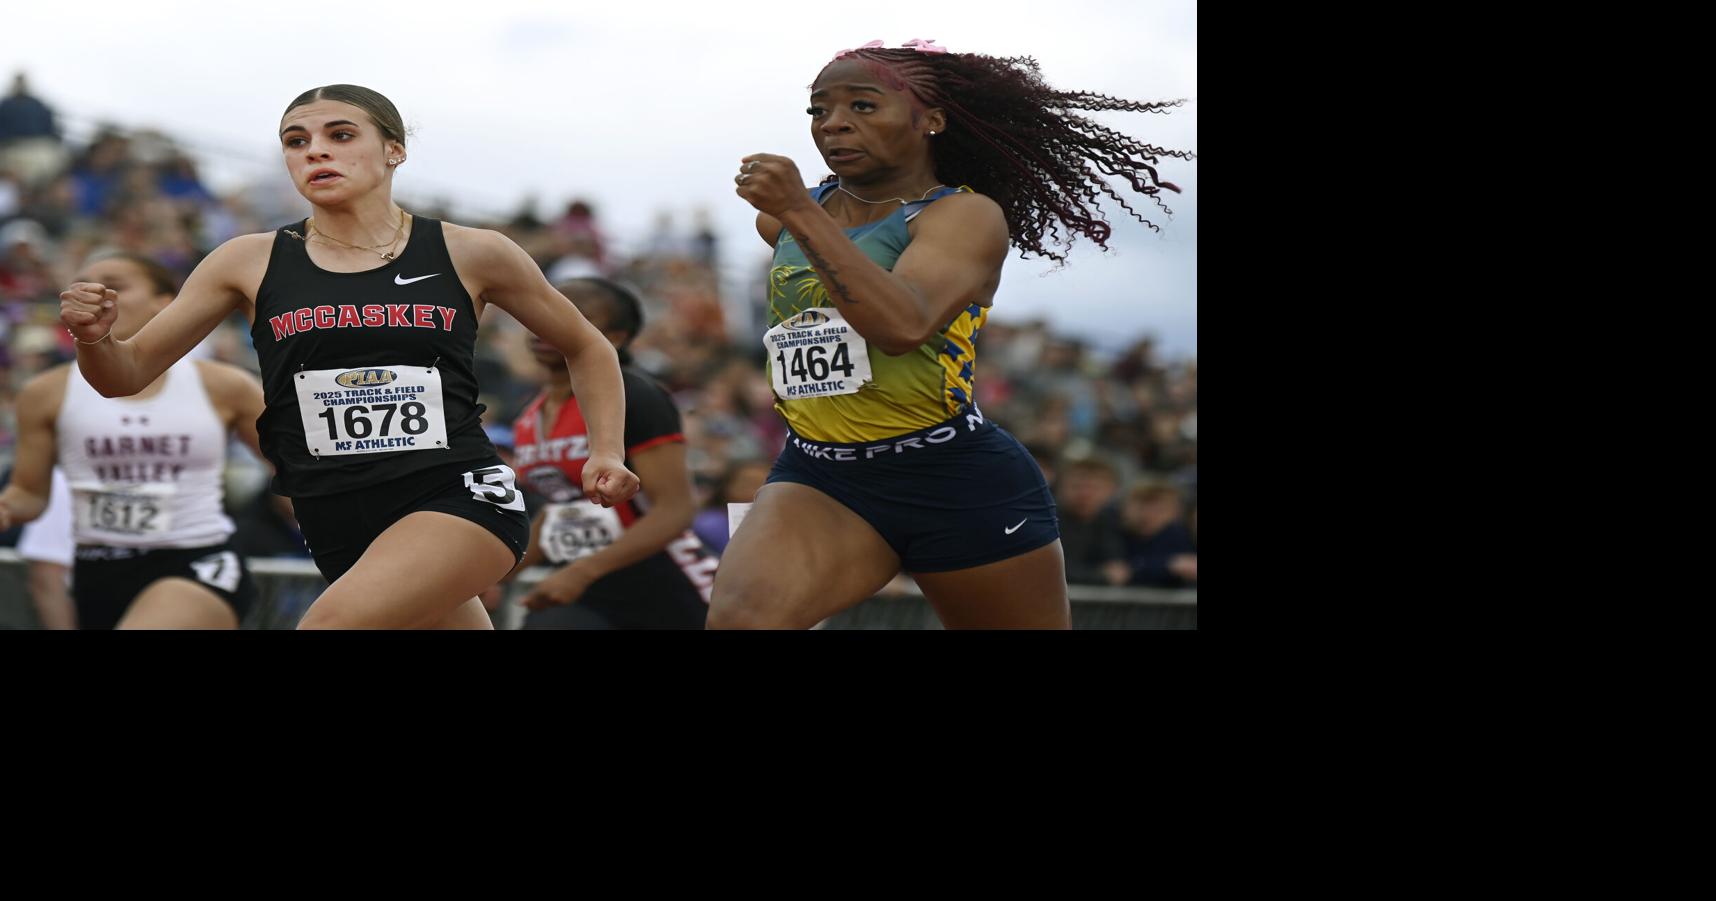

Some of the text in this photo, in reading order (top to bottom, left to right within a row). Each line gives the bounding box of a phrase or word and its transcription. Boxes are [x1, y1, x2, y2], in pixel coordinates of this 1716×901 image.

[269, 304, 457, 342] MCCASKEY
[788, 330, 813, 339] TRACK
[823, 326, 848, 335] FIELD
[777, 343, 854, 384] 1464
[314, 391, 342, 399] 2025
[344, 389, 383, 397] TRACK
[798, 381, 845, 395] ATHLETIC
[323, 394, 416, 406] CHAMPIONSHIPS
[318, 402, 429, 440] 1678
[85, 435, 191, 457] GARNET
[355, 437, 415, 450] ATHLETIC
[793, 438, 857, 461] NIKE
[866, 426, 957, 459] PRO
[96, 463, 184, 481] VALLEY
[471, 467, 516, 505] 5
[89, 497, 159, 531] 1612
